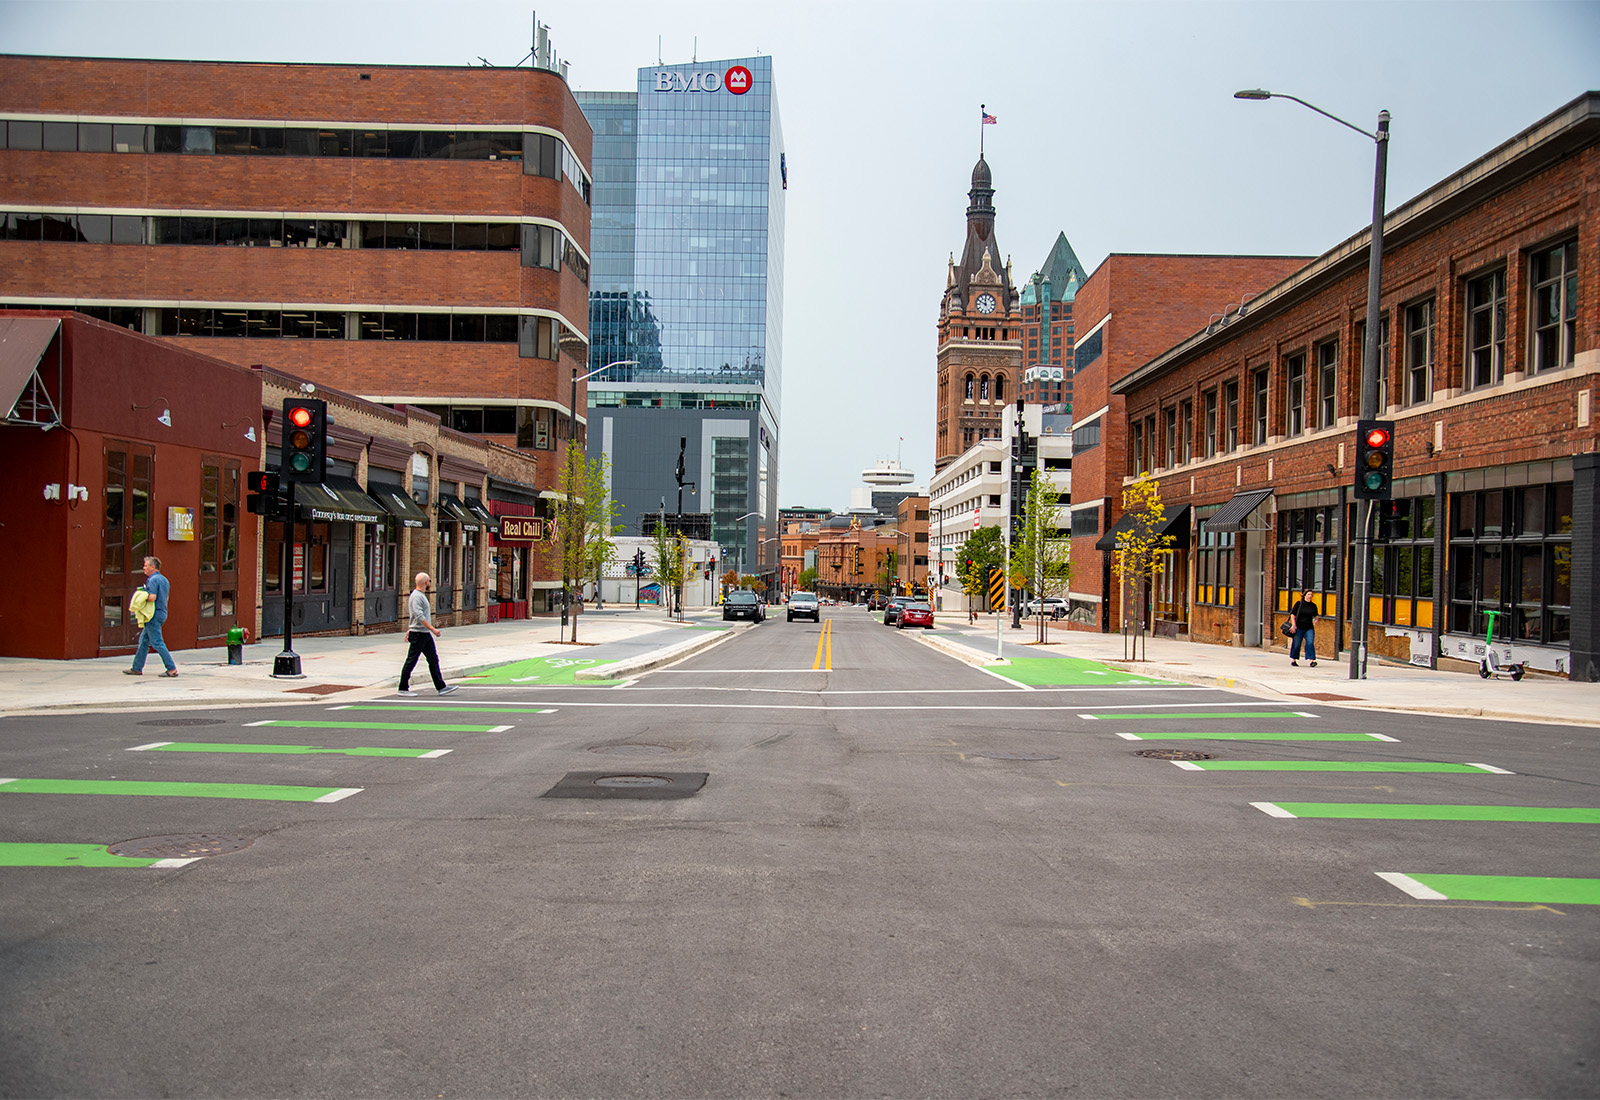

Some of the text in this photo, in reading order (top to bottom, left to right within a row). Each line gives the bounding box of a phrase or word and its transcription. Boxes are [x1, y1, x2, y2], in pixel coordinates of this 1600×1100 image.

[654, 71, 722, 92] BMO
[504, 520, 522, 536] Real
[523, 521, 541, 537] Chili
